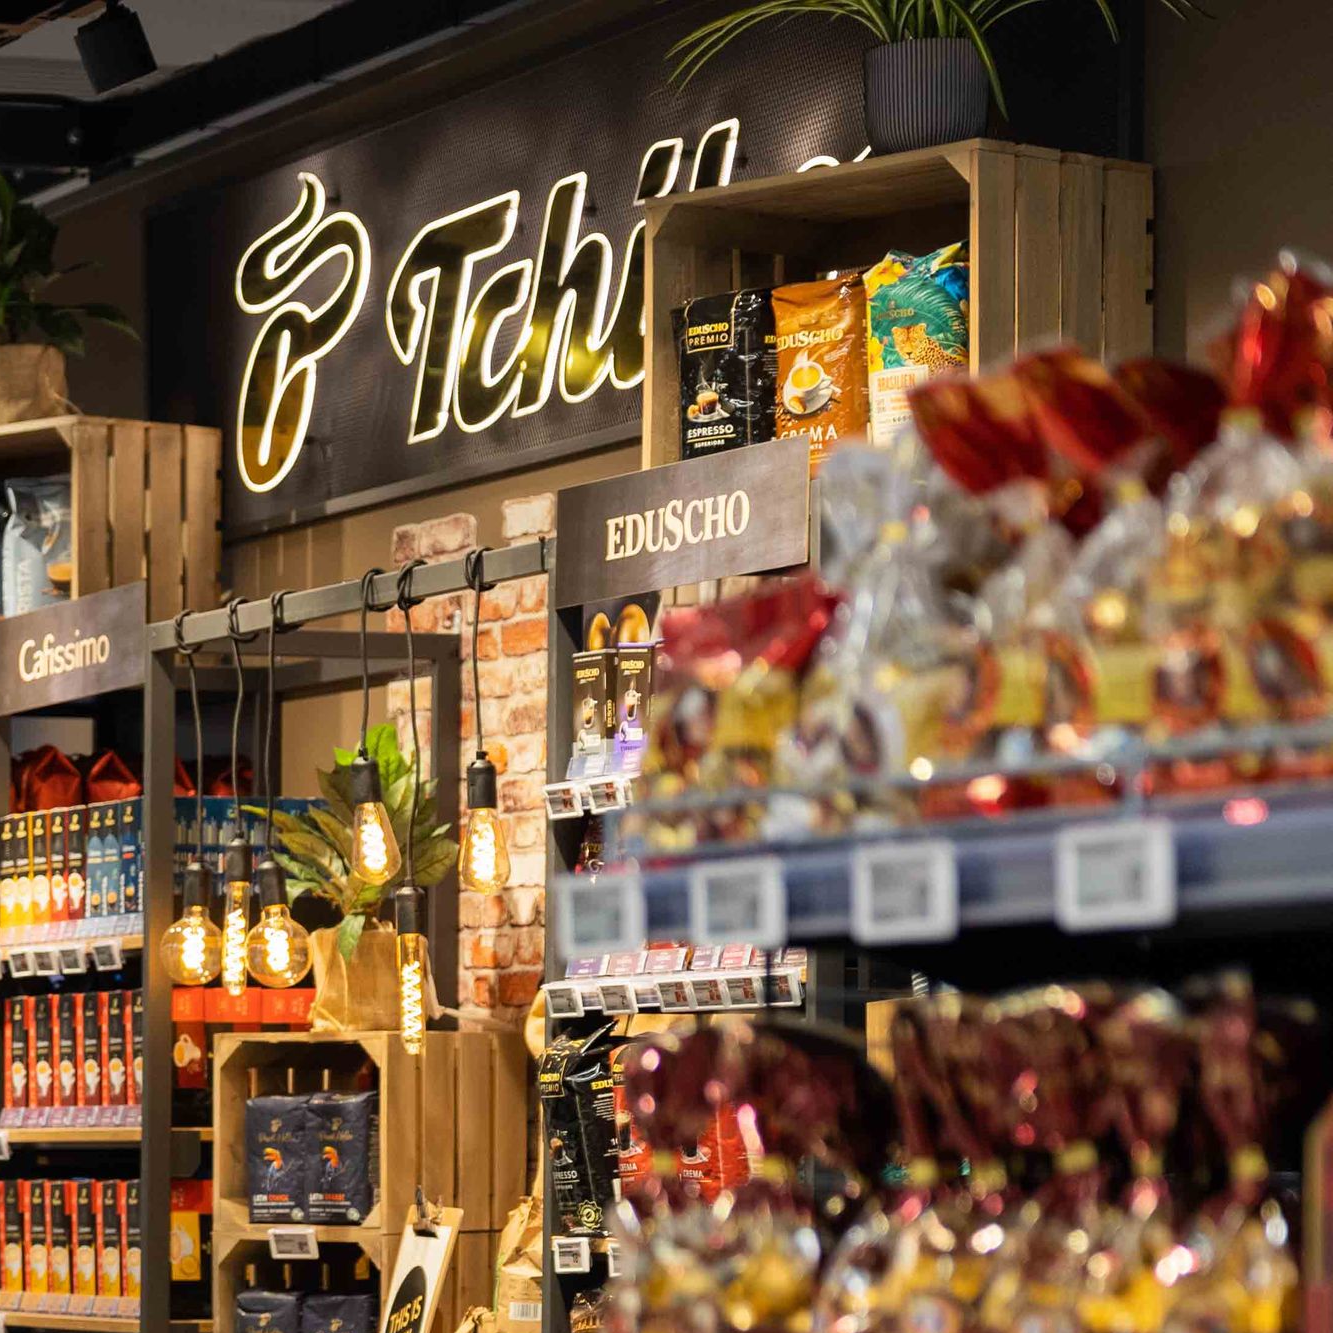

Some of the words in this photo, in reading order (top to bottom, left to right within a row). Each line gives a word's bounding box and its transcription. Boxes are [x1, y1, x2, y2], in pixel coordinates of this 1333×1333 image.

[688, 322, 729, 337] EDUSCHO
[688, 333, 729, 347] PREMIO
[776, 327, 843, 350] EDUSCHO
[687, 424, 734, 438] ESPRESSO
[605, 490, 750, 563] EDUSCHO
[19, 630, 110, 682] Cafissimo
[411, 1295, 423, 1320] IS
